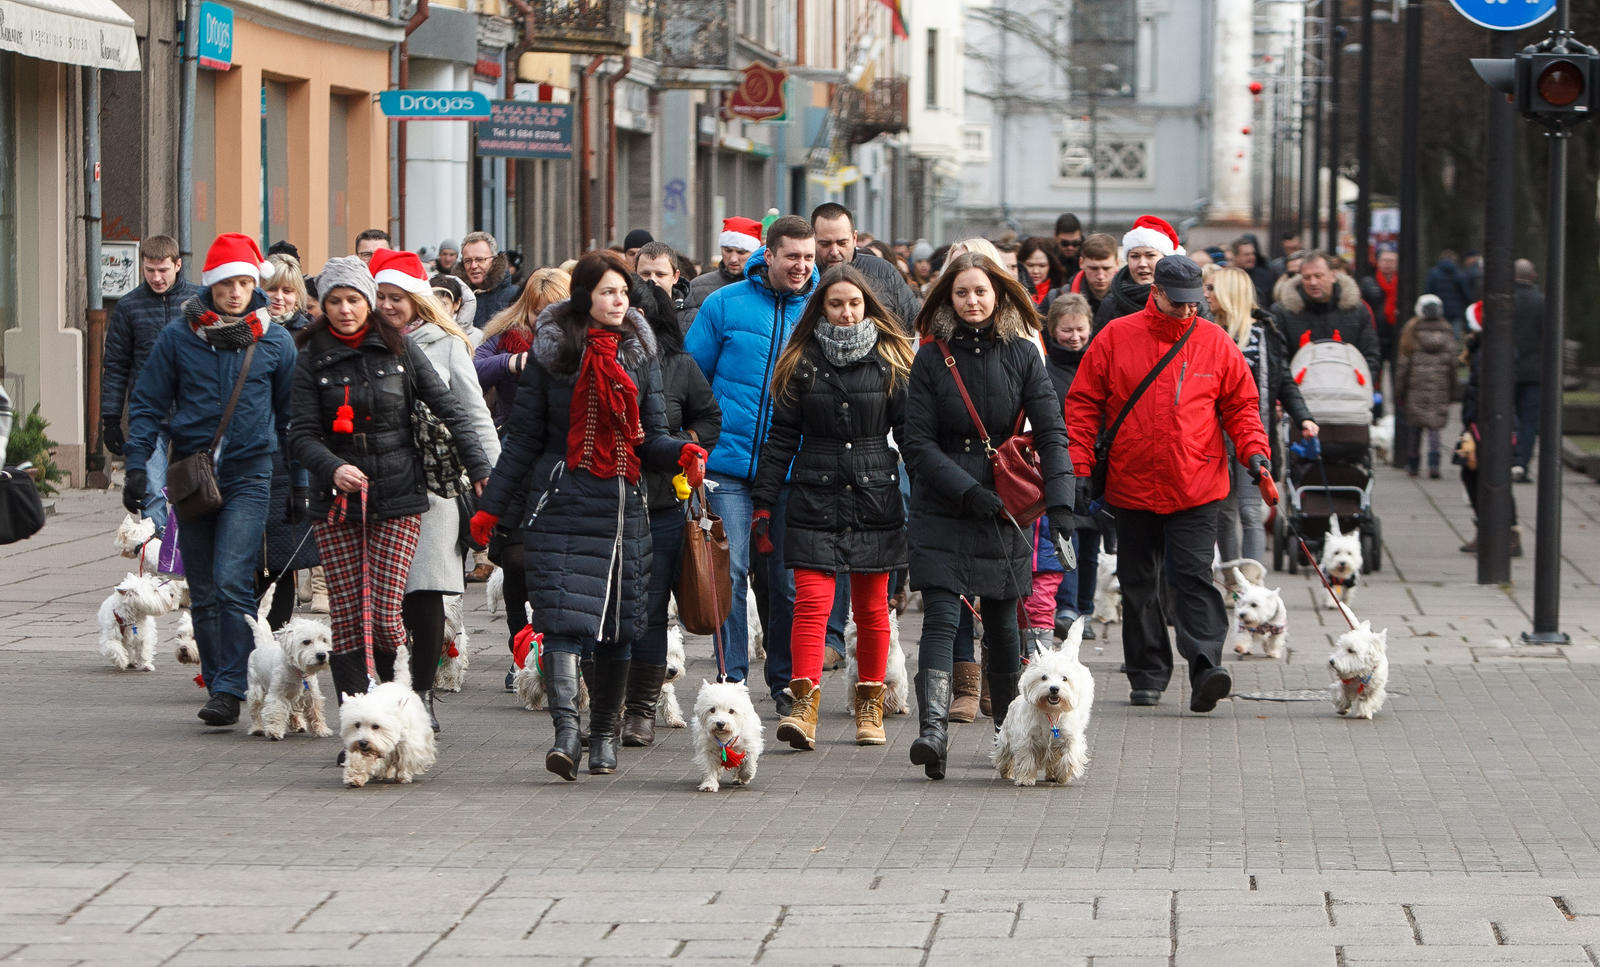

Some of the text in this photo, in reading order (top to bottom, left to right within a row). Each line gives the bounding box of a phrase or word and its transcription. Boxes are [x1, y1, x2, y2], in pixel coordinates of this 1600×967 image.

[207, 13, 230, 54] Drogas
[400, 95, 475, 113] Drogas
[492, 127, 507, 137] Tel.
